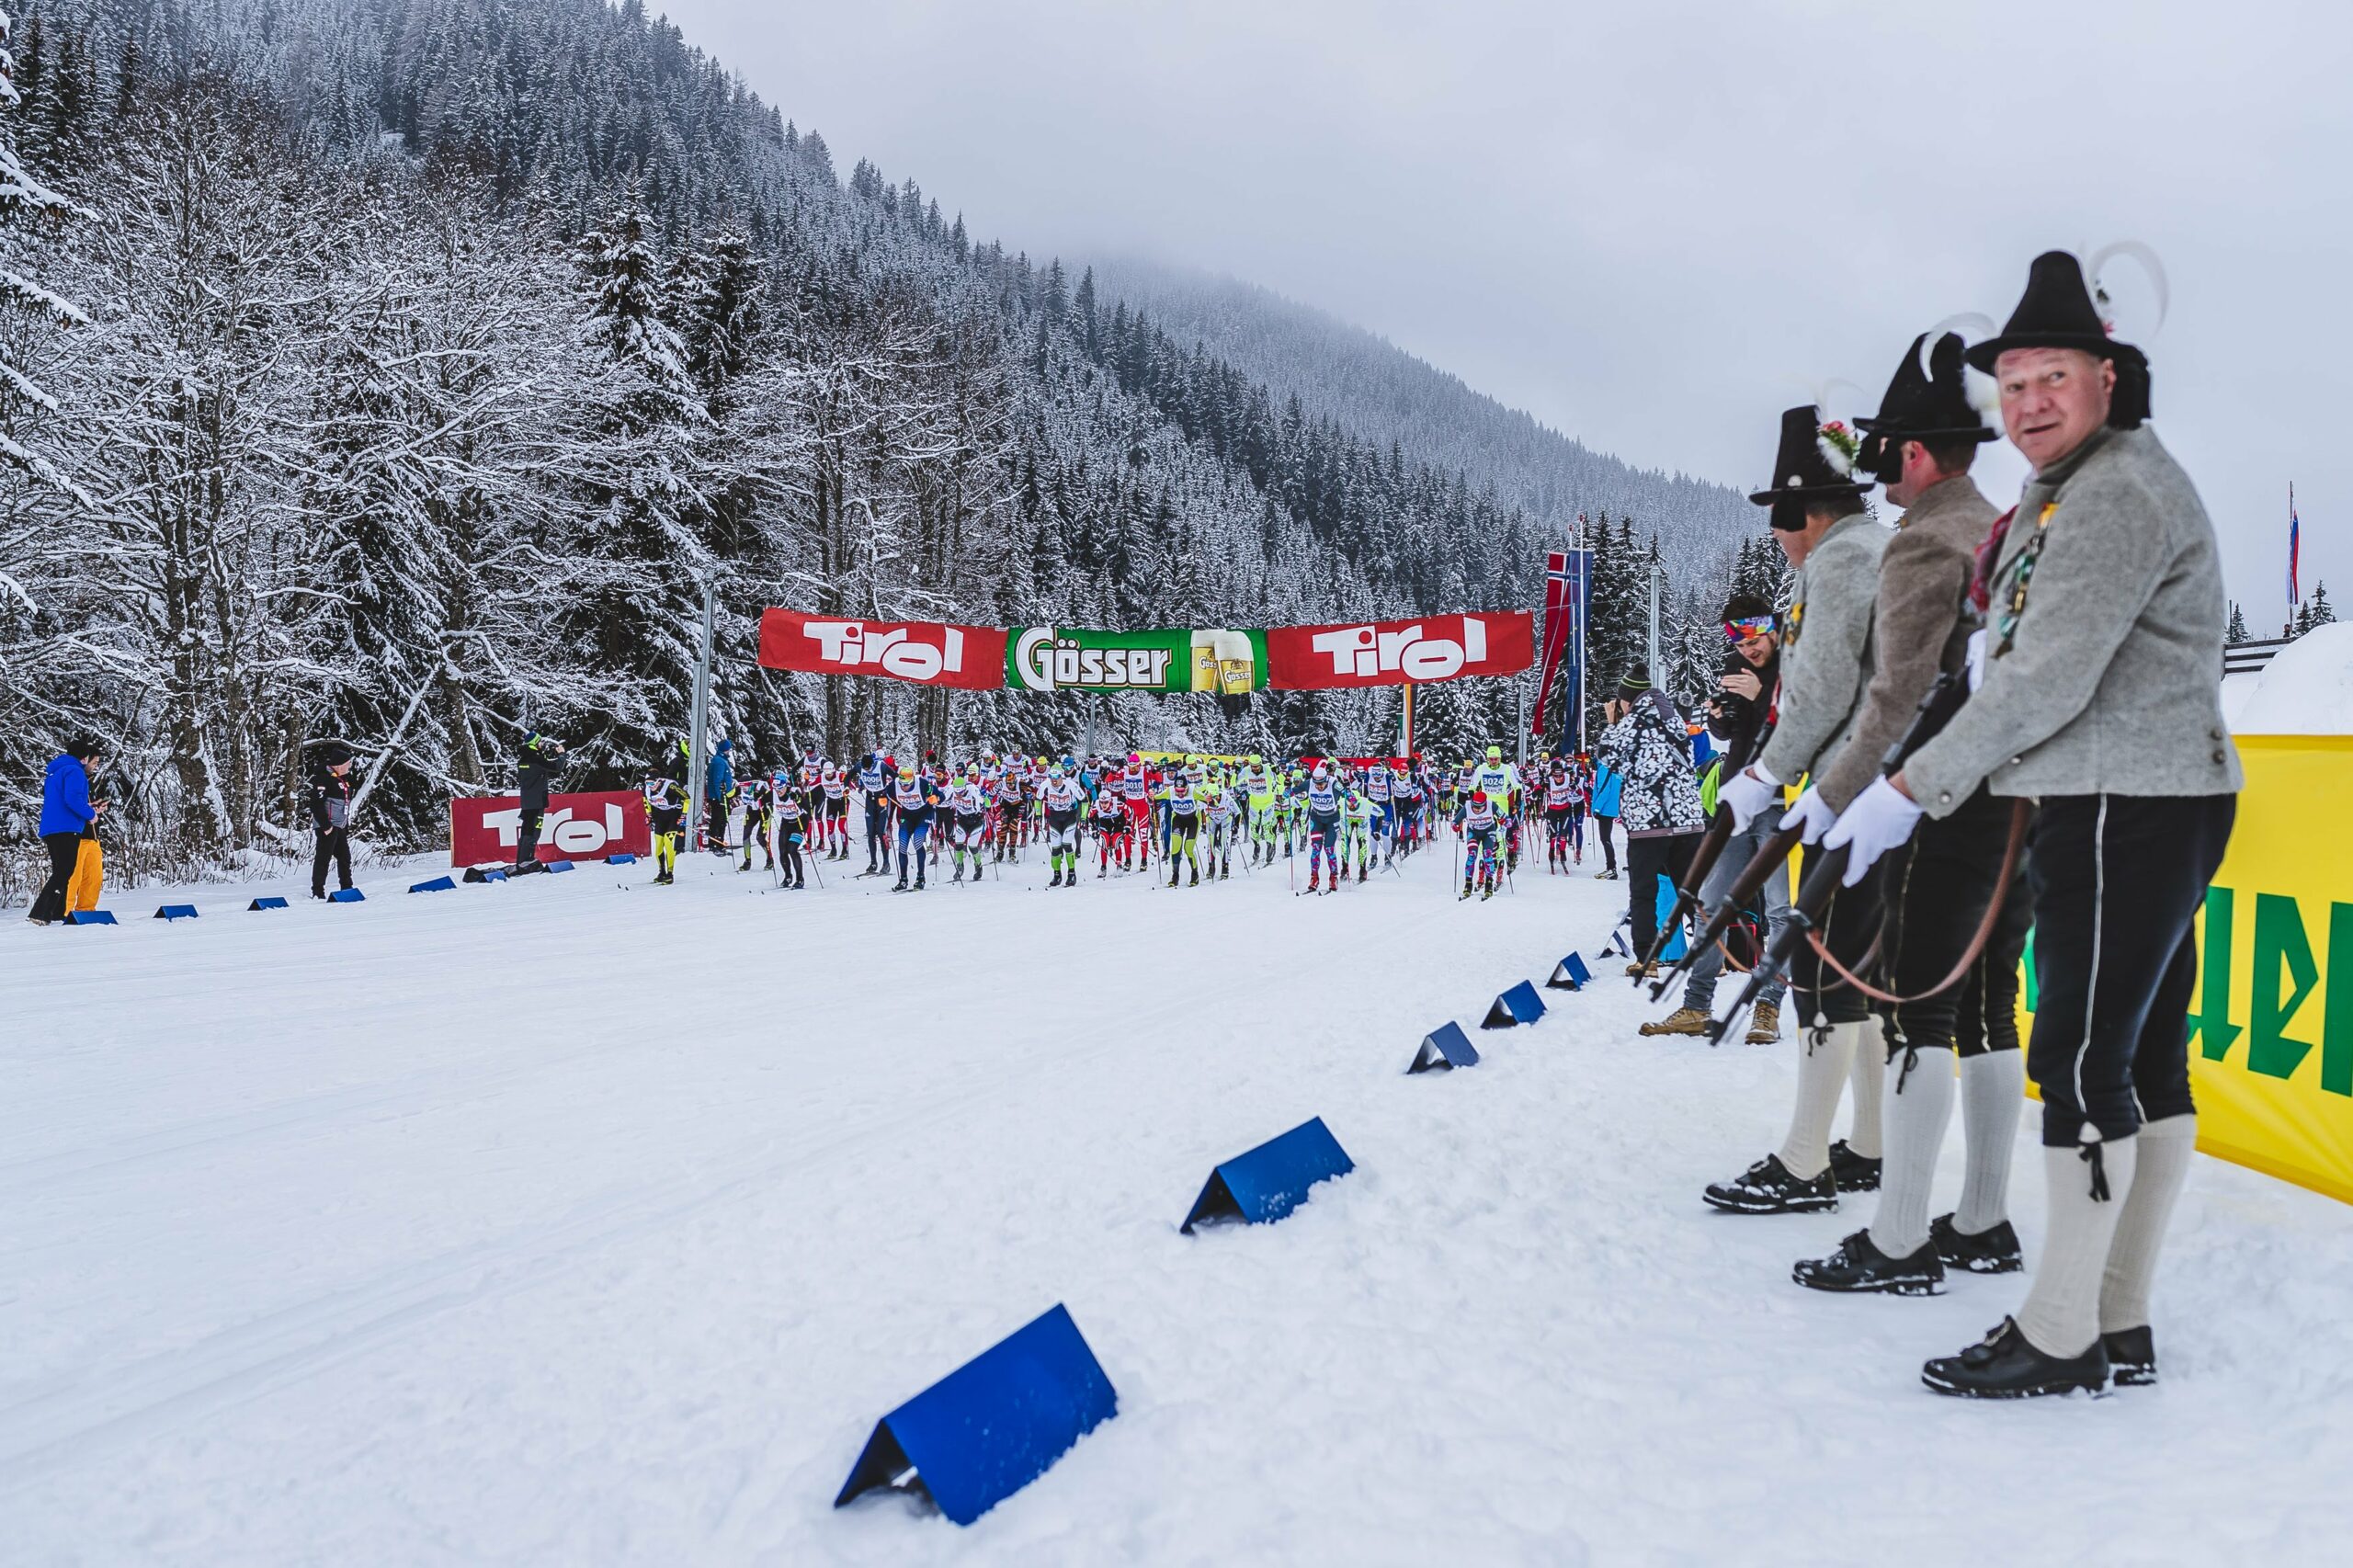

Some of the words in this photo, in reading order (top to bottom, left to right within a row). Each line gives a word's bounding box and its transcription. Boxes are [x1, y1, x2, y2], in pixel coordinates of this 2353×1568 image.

[803, 621, 964, 681] Tirol
[1016, 627, 1172, 691] Gösser
[1313, 617, 1487, 680] Tirol
[1125, 781, 1143, 790] 3010
[1483, 777, 1504, 786] 3024
[483, 802, 623, 853] Trol
